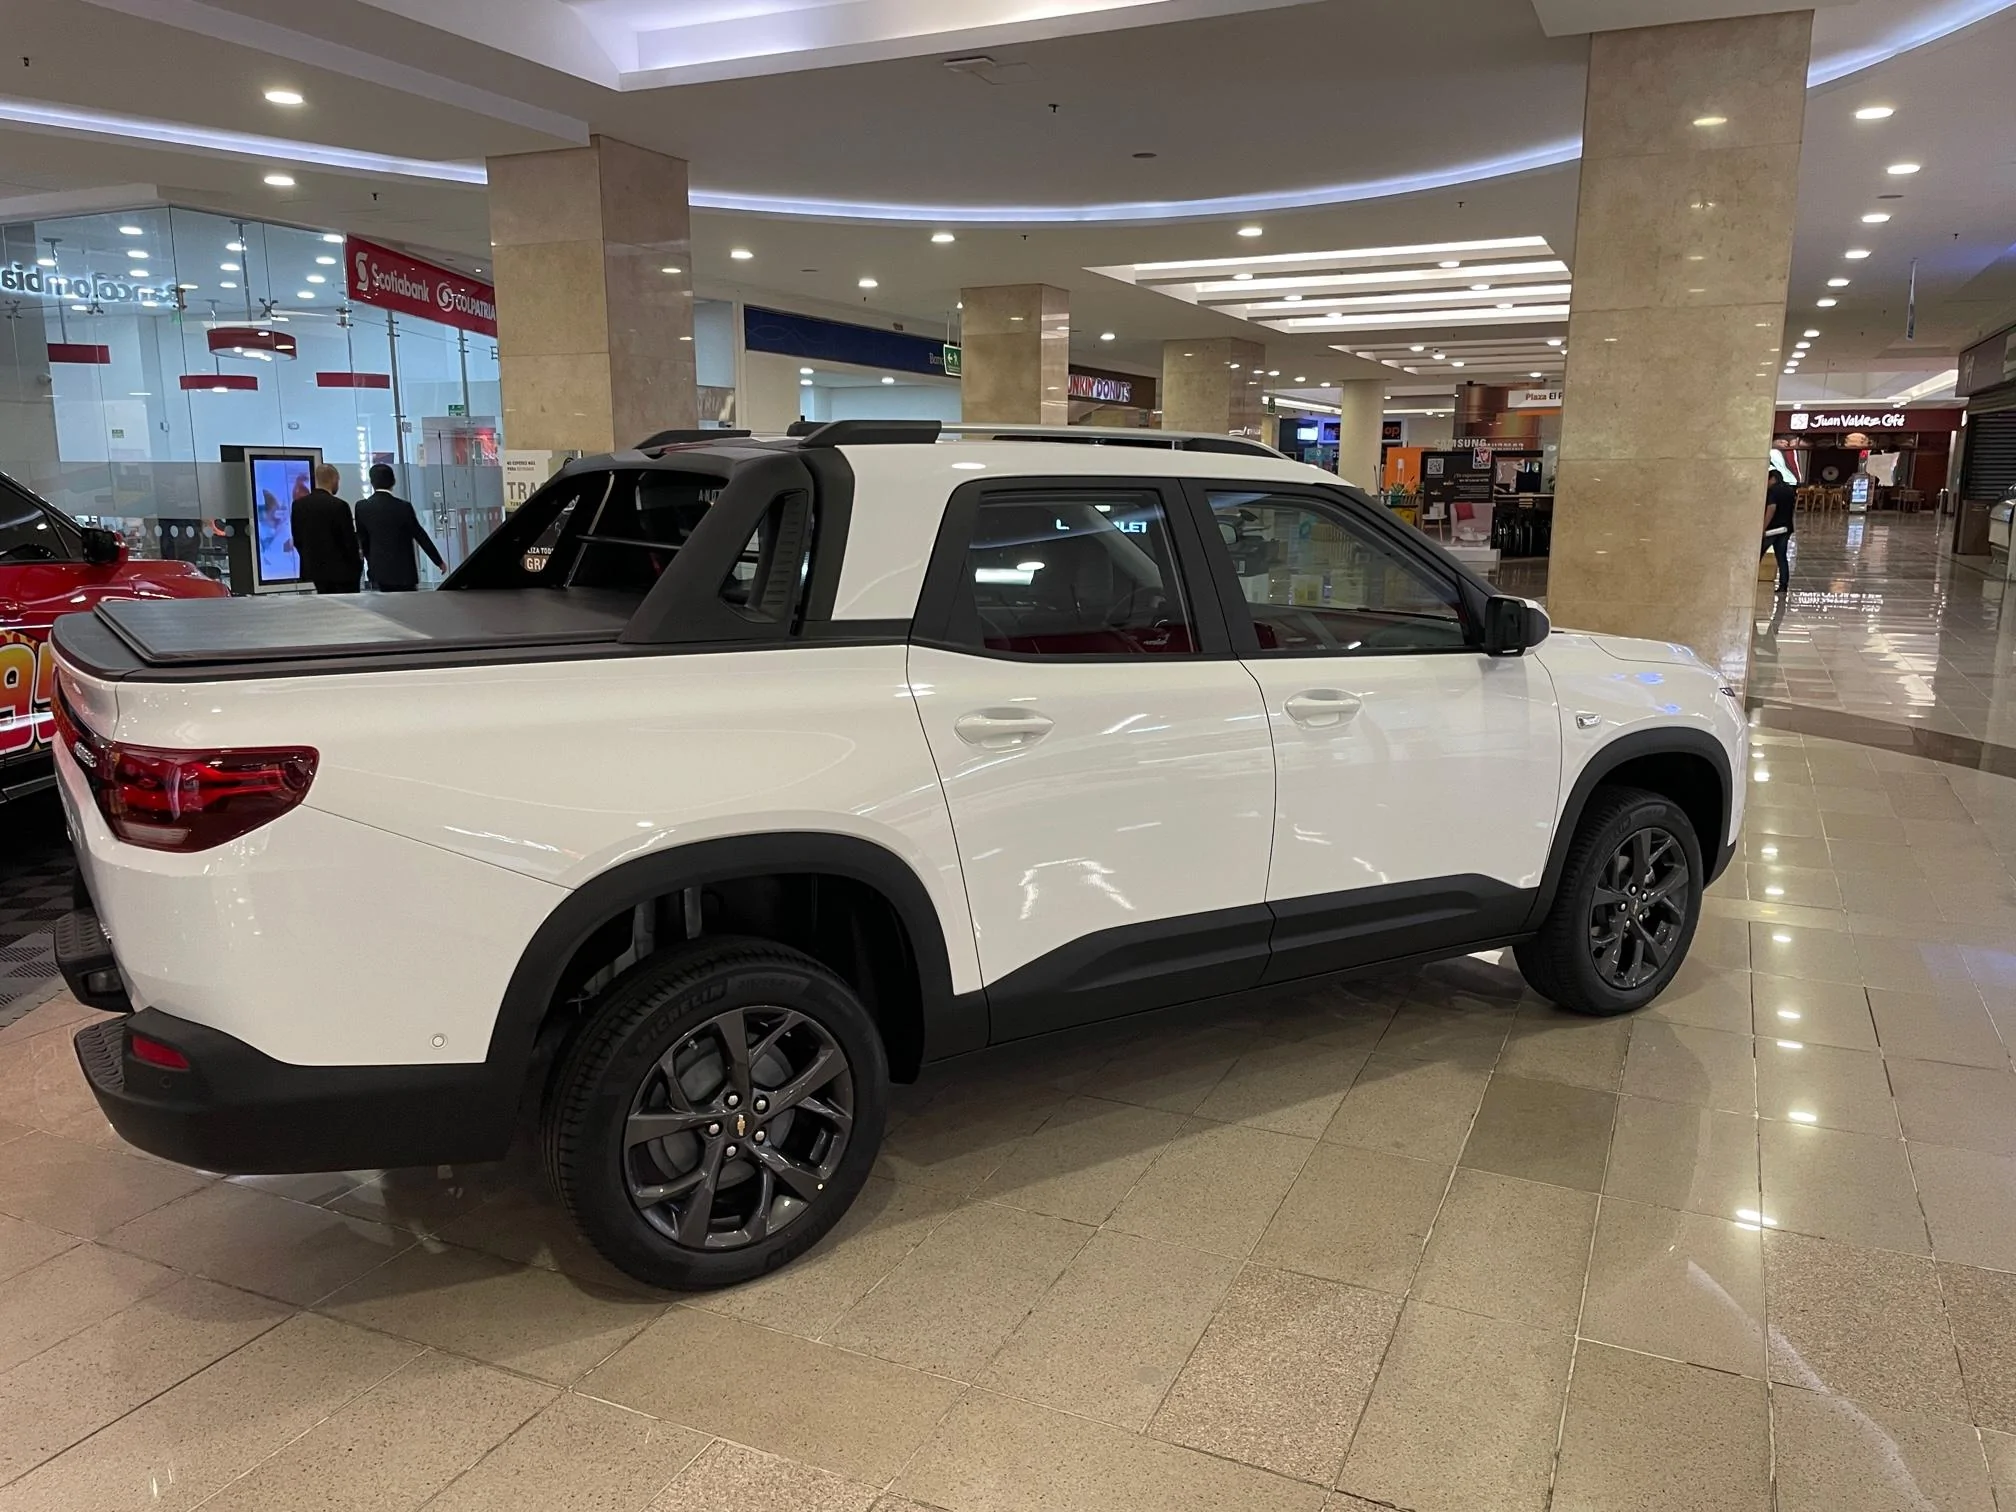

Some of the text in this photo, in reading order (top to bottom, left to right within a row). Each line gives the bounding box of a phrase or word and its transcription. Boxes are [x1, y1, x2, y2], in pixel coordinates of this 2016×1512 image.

[371, 262, 496, 320] Scotiabank COLPATRIA
[1096, 378, 1130, 402] DONUTS
[1525, 392, 1547, 401] Plaza
[1549, 391, 1557, 400] El
[1810, 414, 1840, 428] Juan
[1881, 413, 1905, 427] Café
[1433, 438, 1488, 449] SAMSUNG
[506, 481, 545, 500] TRA
